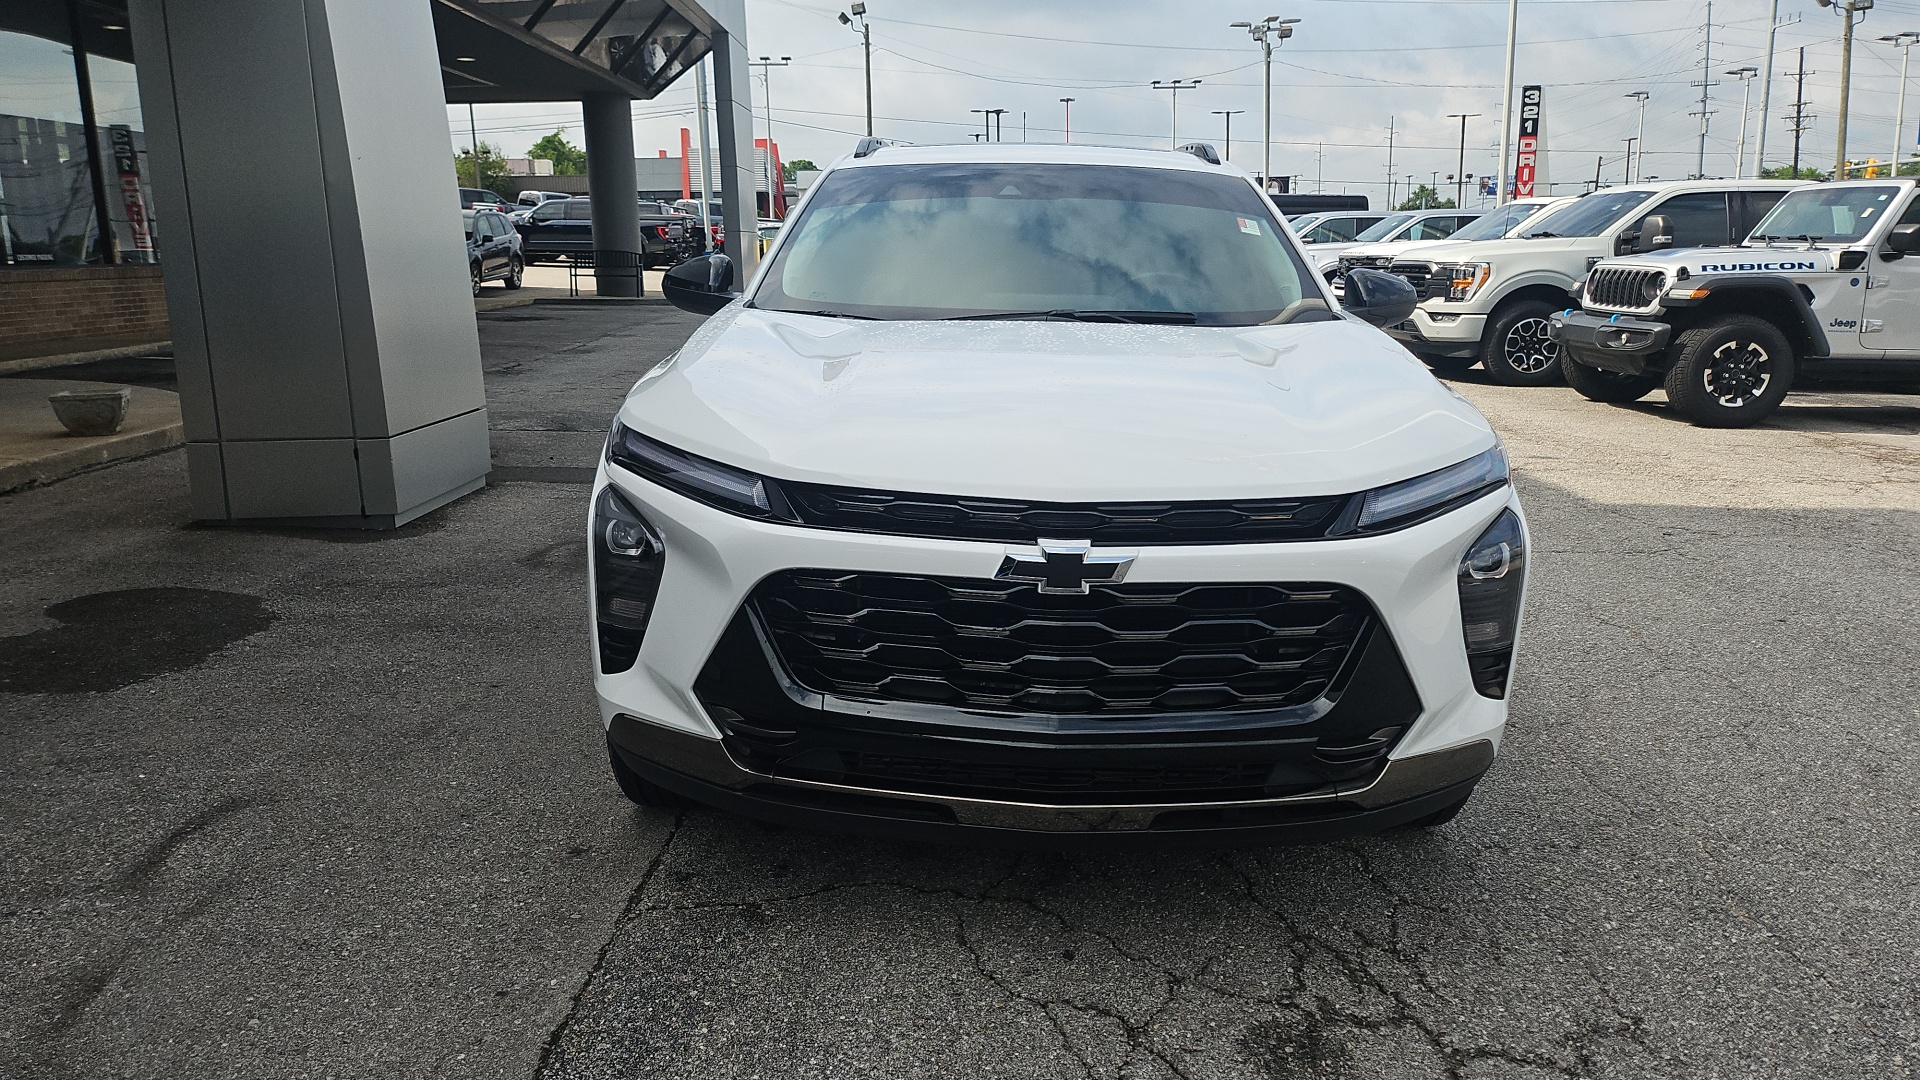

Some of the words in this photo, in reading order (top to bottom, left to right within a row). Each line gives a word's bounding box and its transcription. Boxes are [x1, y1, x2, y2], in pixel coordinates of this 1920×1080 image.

[1523, 90, 1540, 133] 321
[1518, 139, 1537, 199] DRIV
[1701, 261, 1816, 272] RUBICON
[1829, 317, 1857, 329] Jeep
